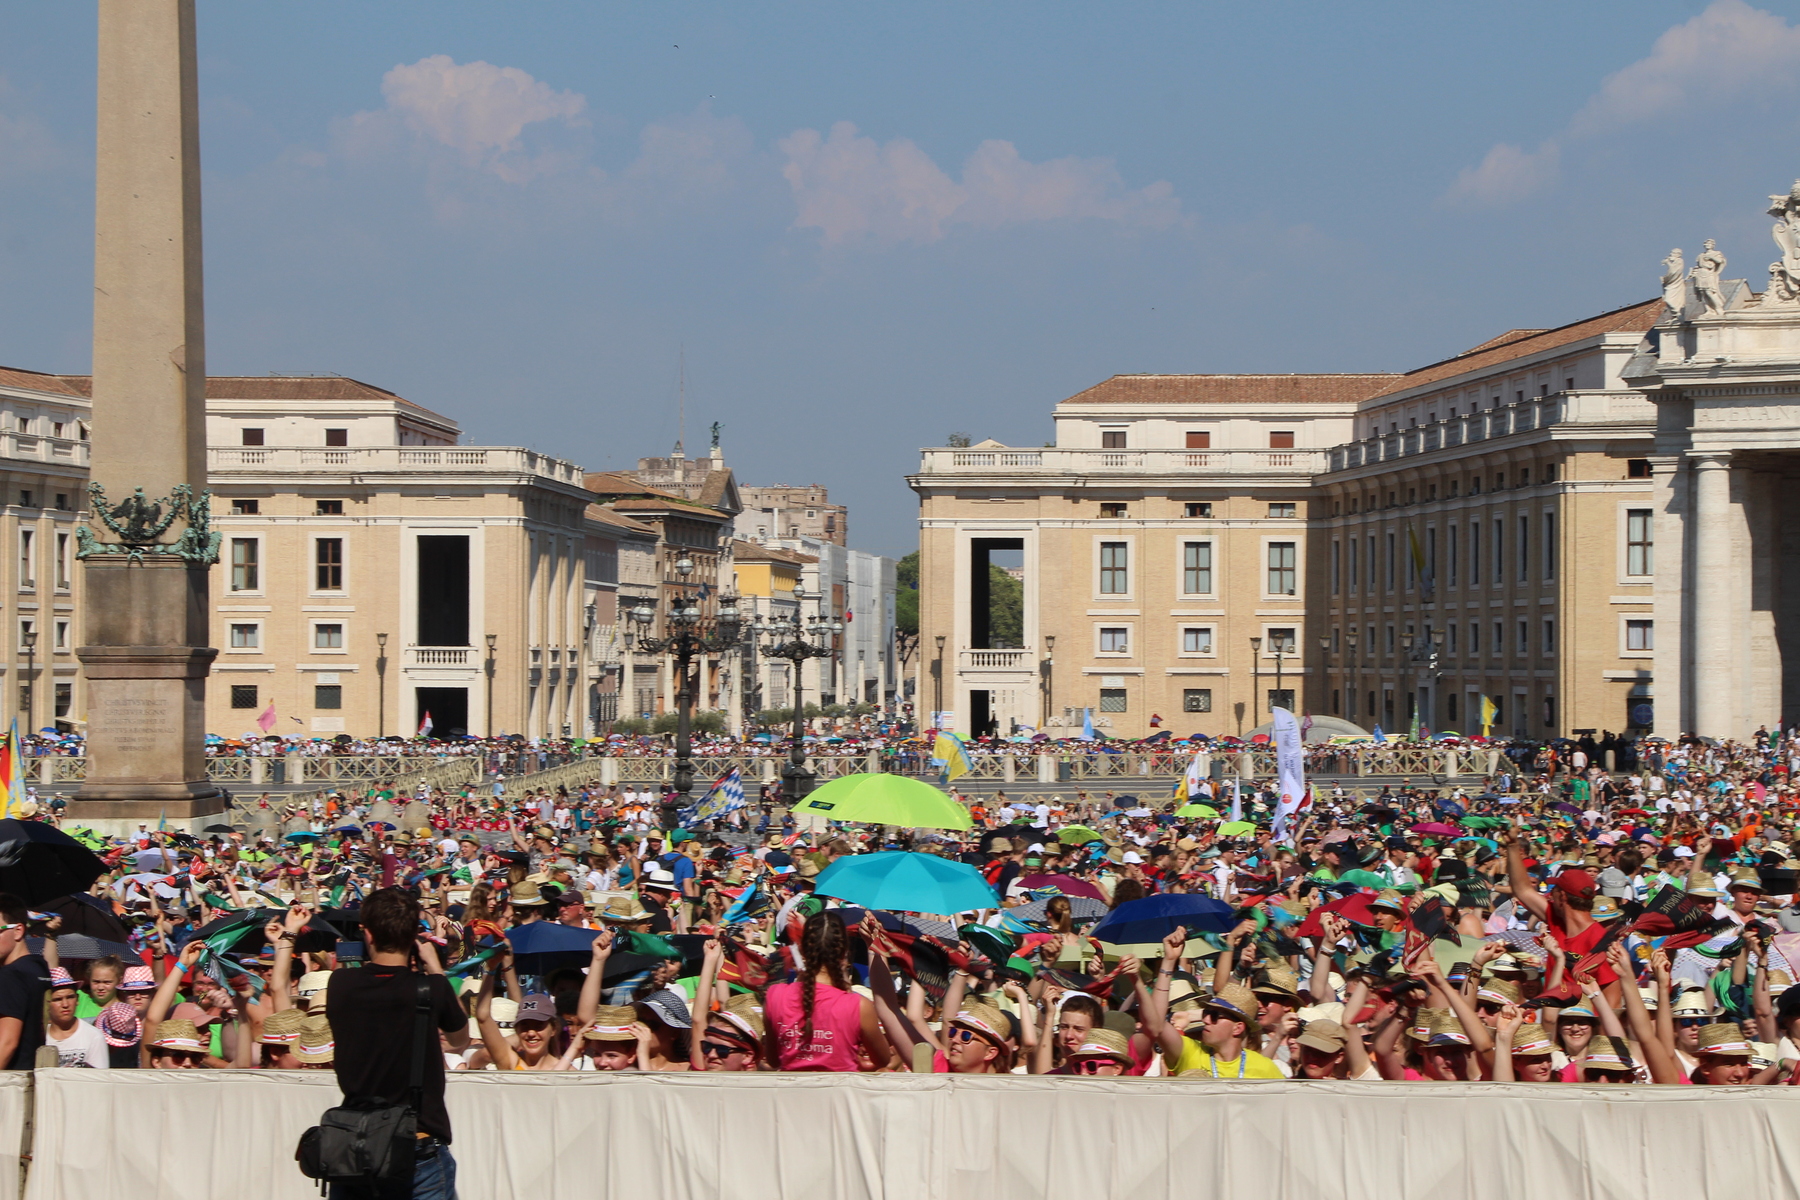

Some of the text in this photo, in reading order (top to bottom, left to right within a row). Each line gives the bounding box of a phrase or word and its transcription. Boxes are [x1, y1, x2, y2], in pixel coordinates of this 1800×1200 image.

[1678, 906, 1704, 928] EACE
[522, 1001, 538, 1011] M
[813, 1030, 834, 1040] me
